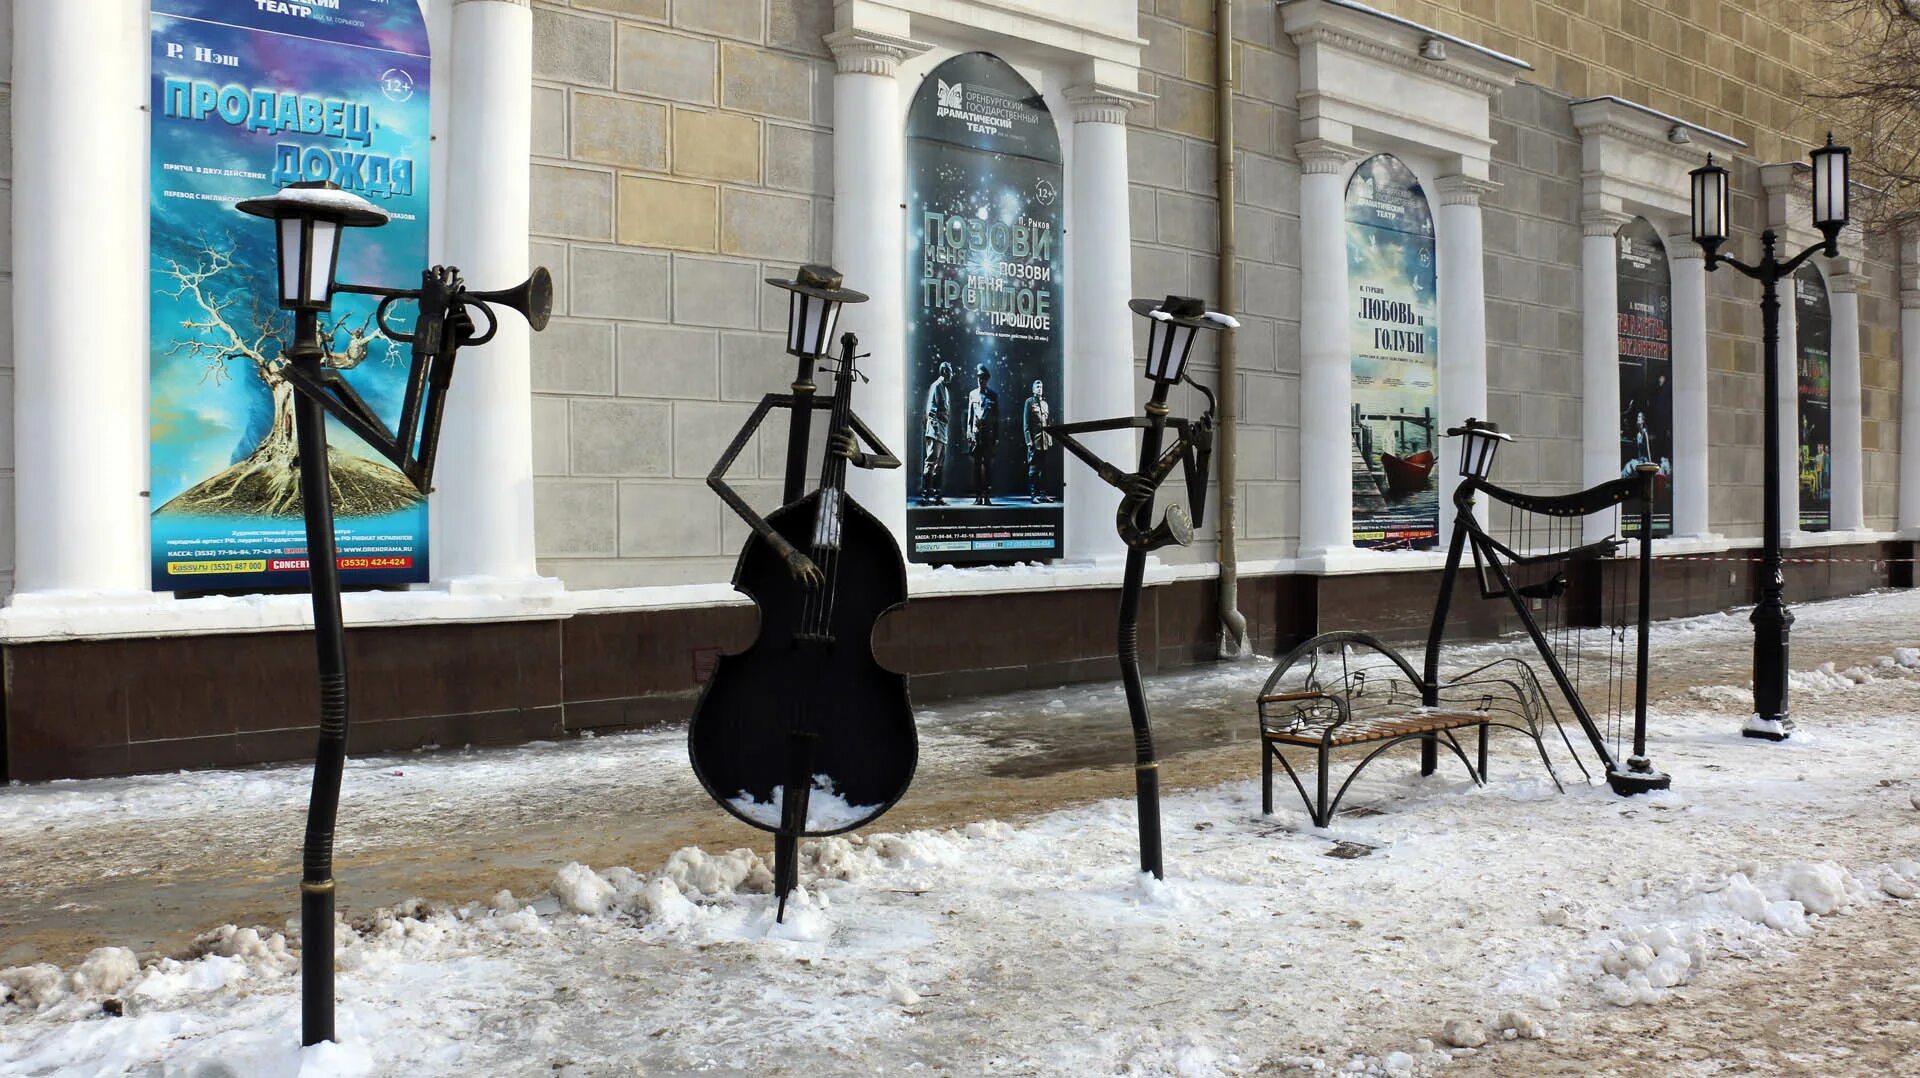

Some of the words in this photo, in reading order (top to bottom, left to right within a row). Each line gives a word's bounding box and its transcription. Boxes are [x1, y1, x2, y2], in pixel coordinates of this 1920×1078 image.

[254, 0, 312, 18] ТЕАТР
[166, 42, 184, 59] Р.
[195, 46, 240, 67] Нэш
[386, 79, 411, 92] 12+
[164, 76, 374, 148] ПРОДАВЕЦ
[966, 92, 1024, 112] ОРЕНБУРГСКИЙ
[937, 106, 1012, 130] ДРАМАТИЧЕСКИЙ
[966, 101, 1039, 125] ГОСУДАРСТВЕННЫЙ
[966, 122, 998, 136] ТЕАТР
[272, 143, 414, 200] ДОЖДЯ
[163, 190, 195, 199] ПЕРЕВОД
[924, 211, 1050, 261] ПОЗОВИ
[924, 243, 968, 265] МЕНЯ
[924, 261, 934, 278] В
[1000, 261, 1051, 282] ПОЗОВИ
[967, 274, 1003, 293] МЕНЯ
[924, 277, 1050, 317] ПРОШЛОЕ
[967, 289, 977, 304] В
[991, 311, 1051, 331] ПРОШЛОЕ
[1358, 297, 1415, 325] ЛЮБОВЬ
[1374, 328, 1425, 354] ГОЛУБИ
[341, 558, 369, 568] (3532)
[370, 557, 405, 567] 424-424
